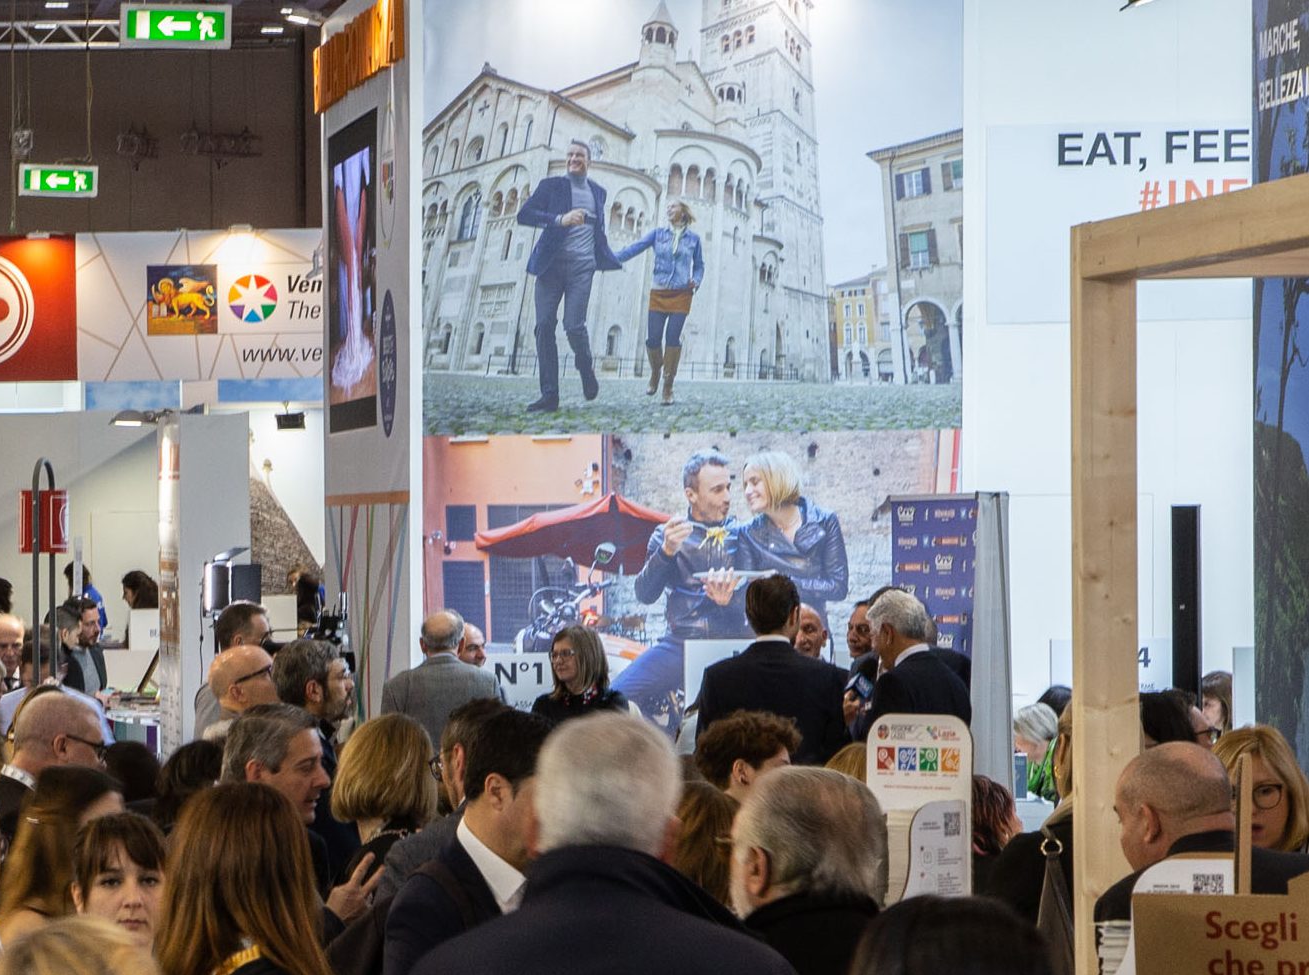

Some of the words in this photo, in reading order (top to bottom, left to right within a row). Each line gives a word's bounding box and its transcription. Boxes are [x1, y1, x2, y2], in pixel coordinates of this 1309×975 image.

[1259, 18, 1301, 61] MARCHE,
[1258, 67, 1304, 112] BELLEZZA
[1057, 131, 1147, 172] EAT,
[1165, 129, 1250, 165] FEE
[287, 275, 323, 294] Ven
[287, 300, 321, 320] The
[243, 346, 323, 363] www.ve
[494, 661, 543, 685] N°1
[1205, 910, 1298, 950] Scegli
